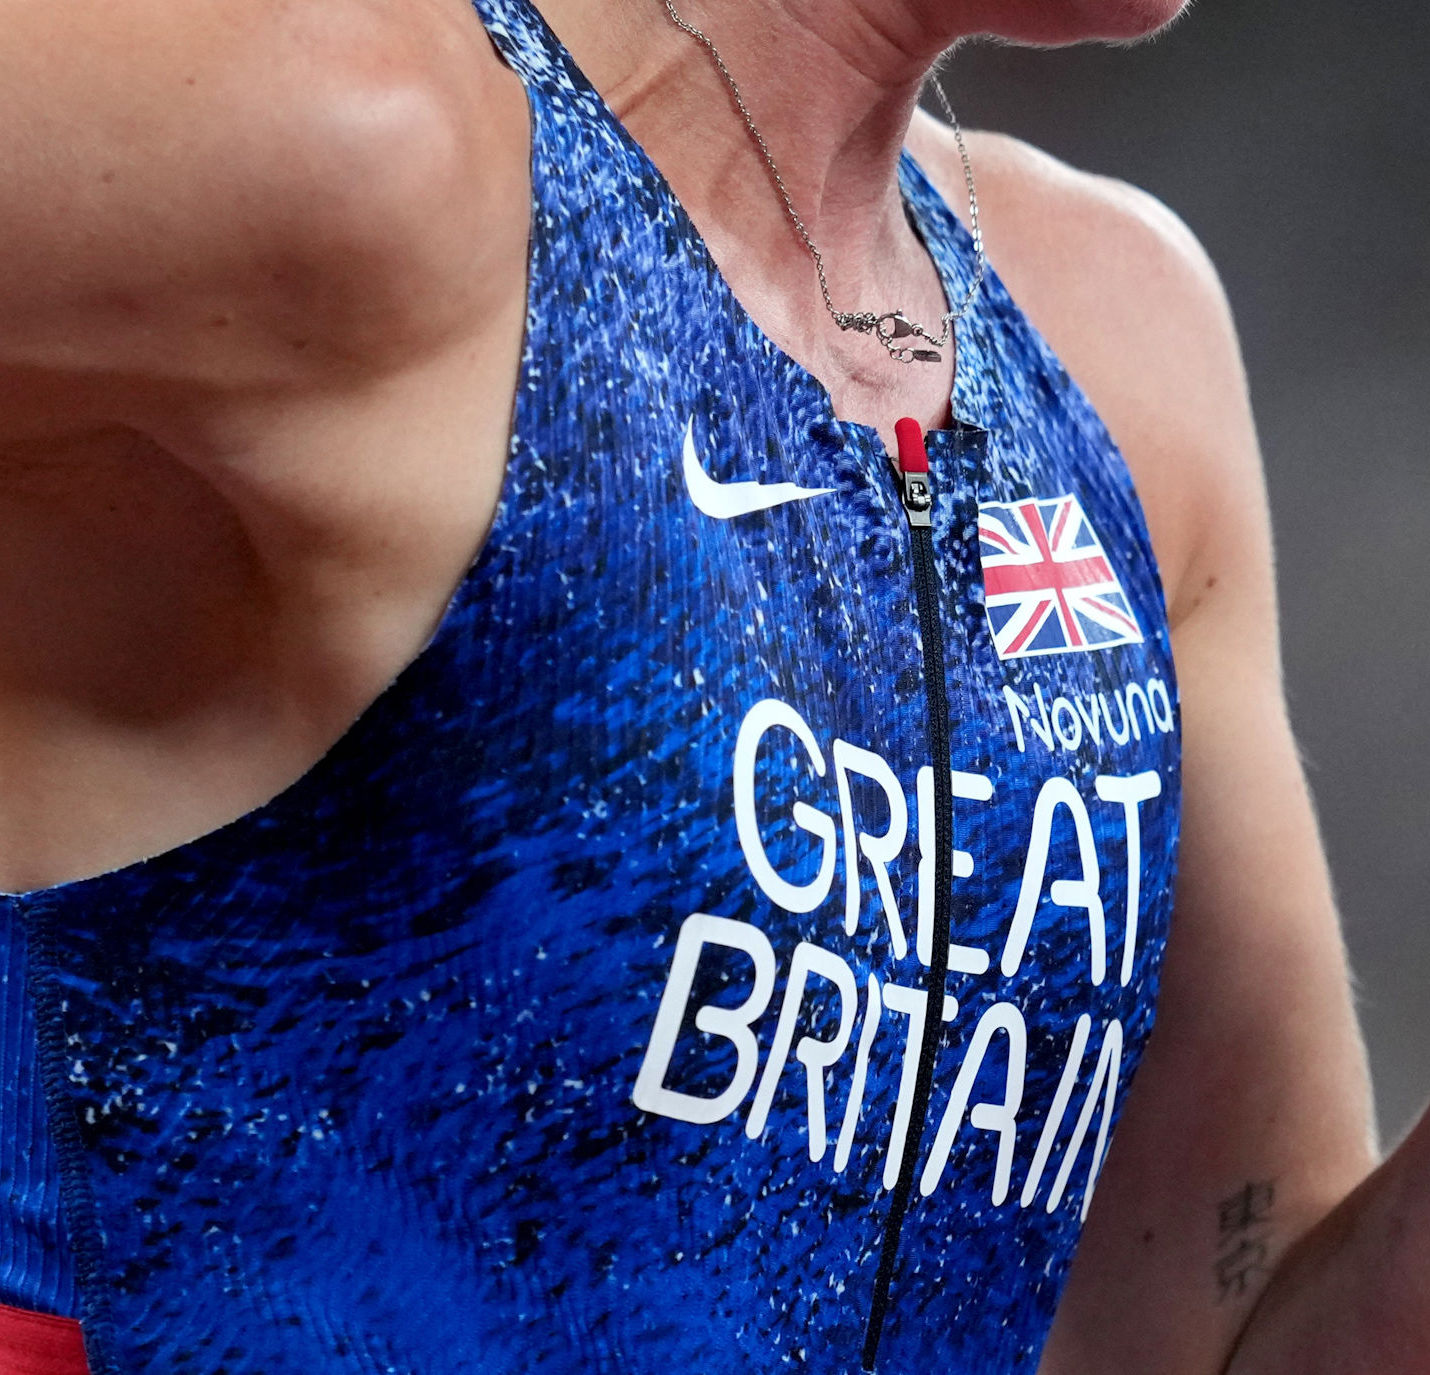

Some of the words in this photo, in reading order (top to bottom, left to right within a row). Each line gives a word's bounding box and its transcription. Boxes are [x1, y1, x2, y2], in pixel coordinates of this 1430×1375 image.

[733, 698, 1162, 988] GREAT
[1002, 677, 1174, 753] Novuna
[632, 912, 1124, 1224] BRITAIN
